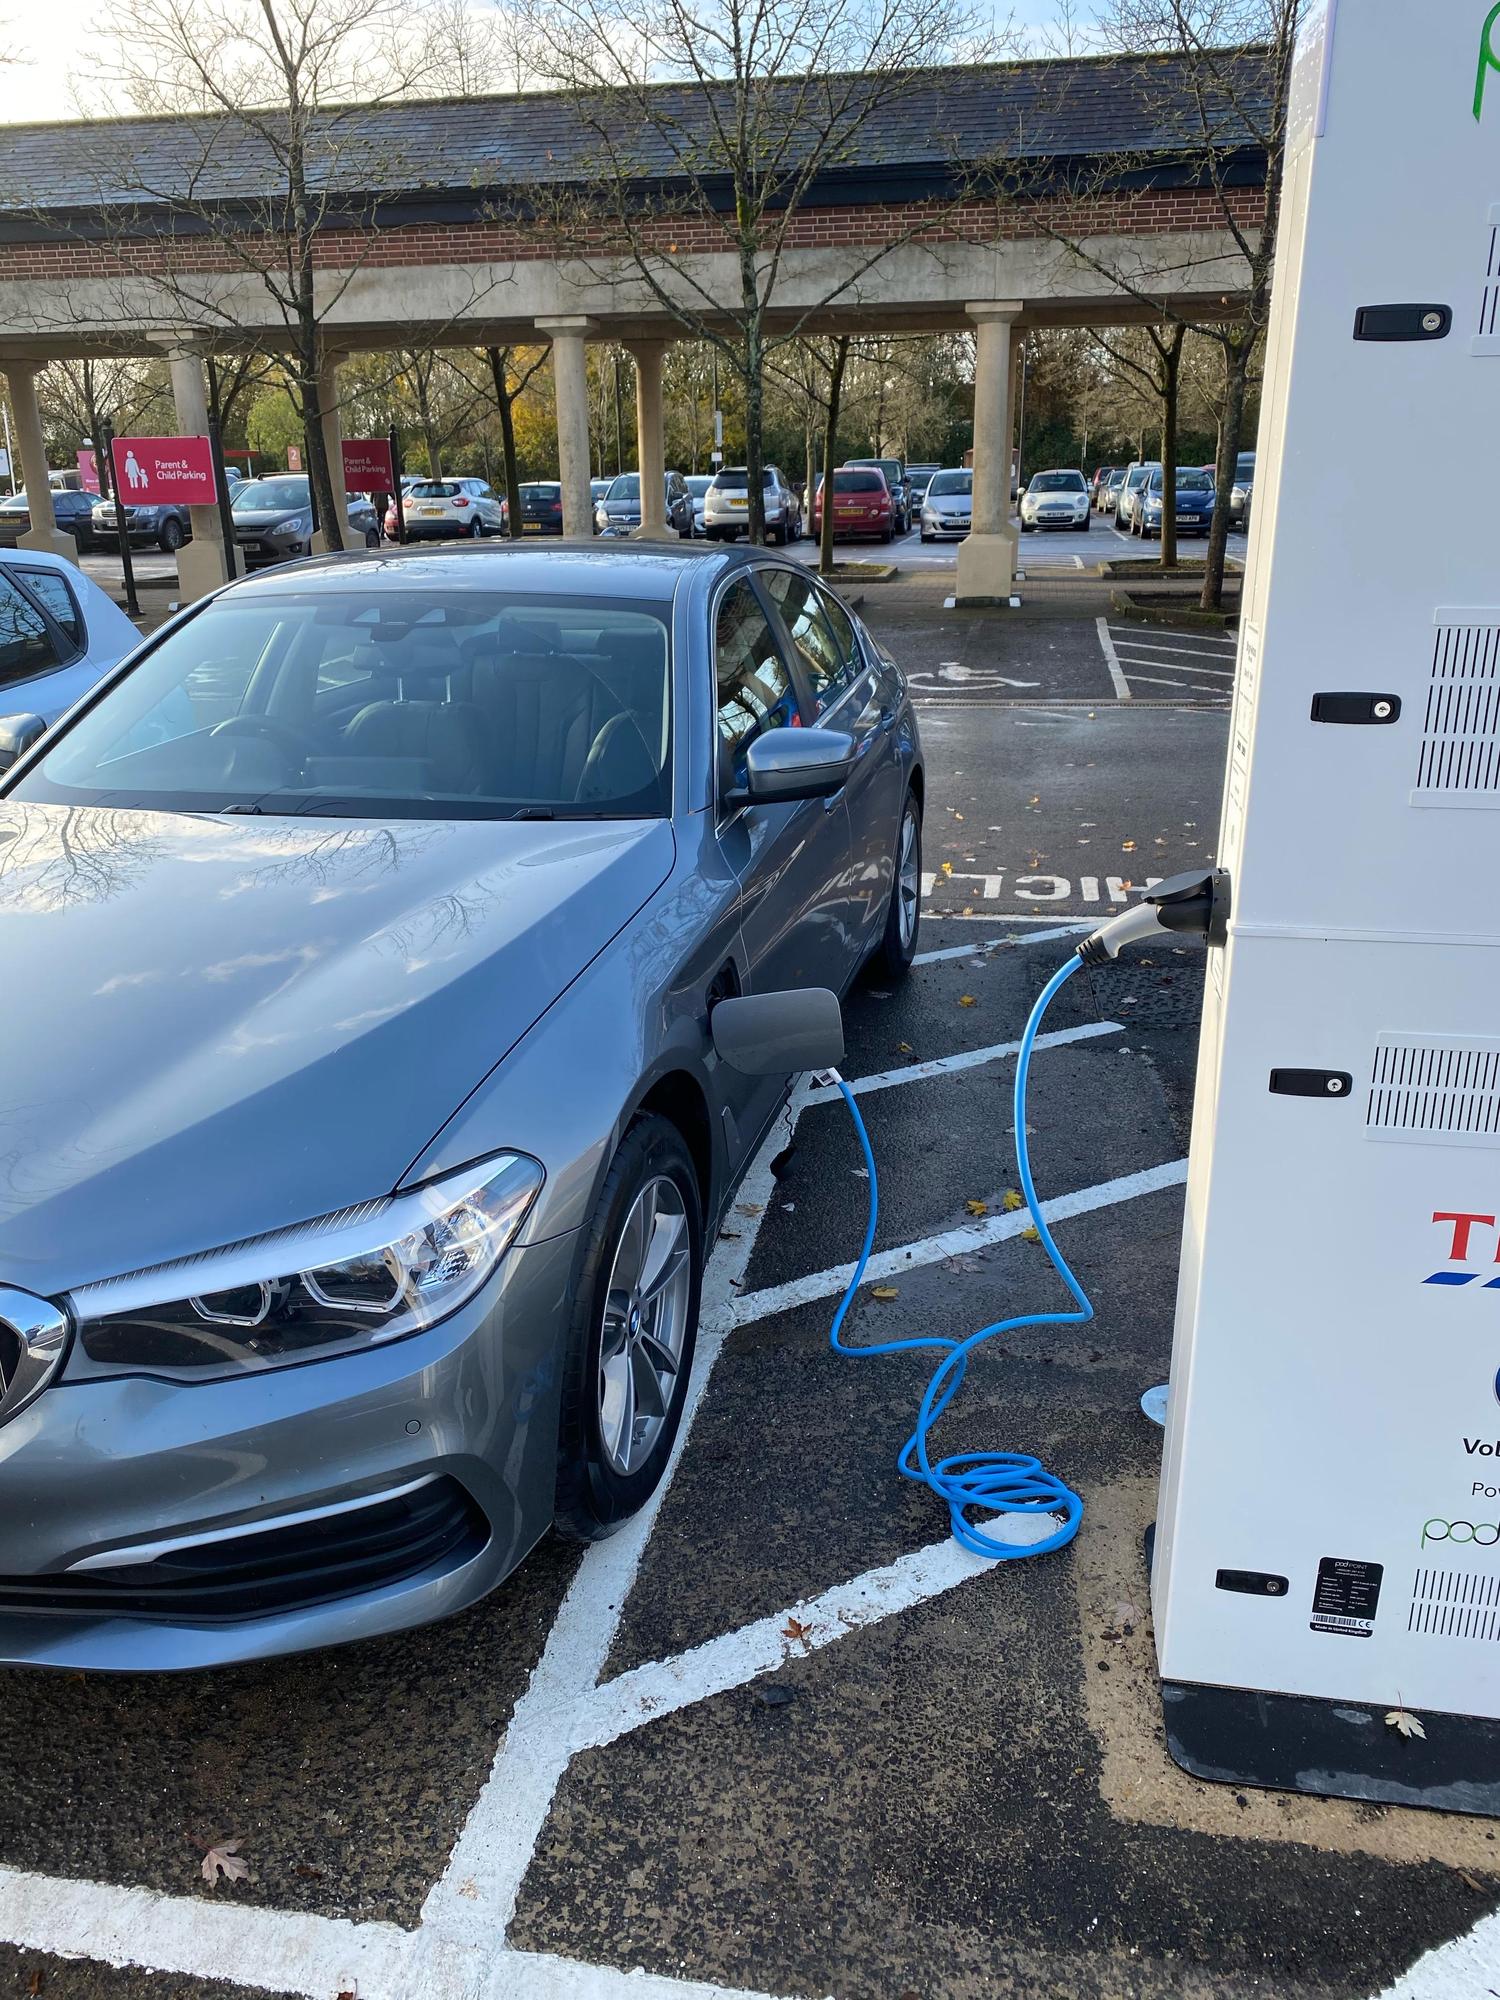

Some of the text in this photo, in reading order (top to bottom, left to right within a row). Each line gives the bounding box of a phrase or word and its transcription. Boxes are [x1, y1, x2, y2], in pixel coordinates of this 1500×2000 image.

[155, 460, 188, 469] Parent &
[344, 457, 365, 465] Parent
[345, 465, 386, 474] Child Parking
[157, 471, 206, 481] Child Parking
[921, 873, 1164, 902] HICL
[1432, 1211, 1500, 1262] T
[1472, 1482, 1500, 1498] Po
